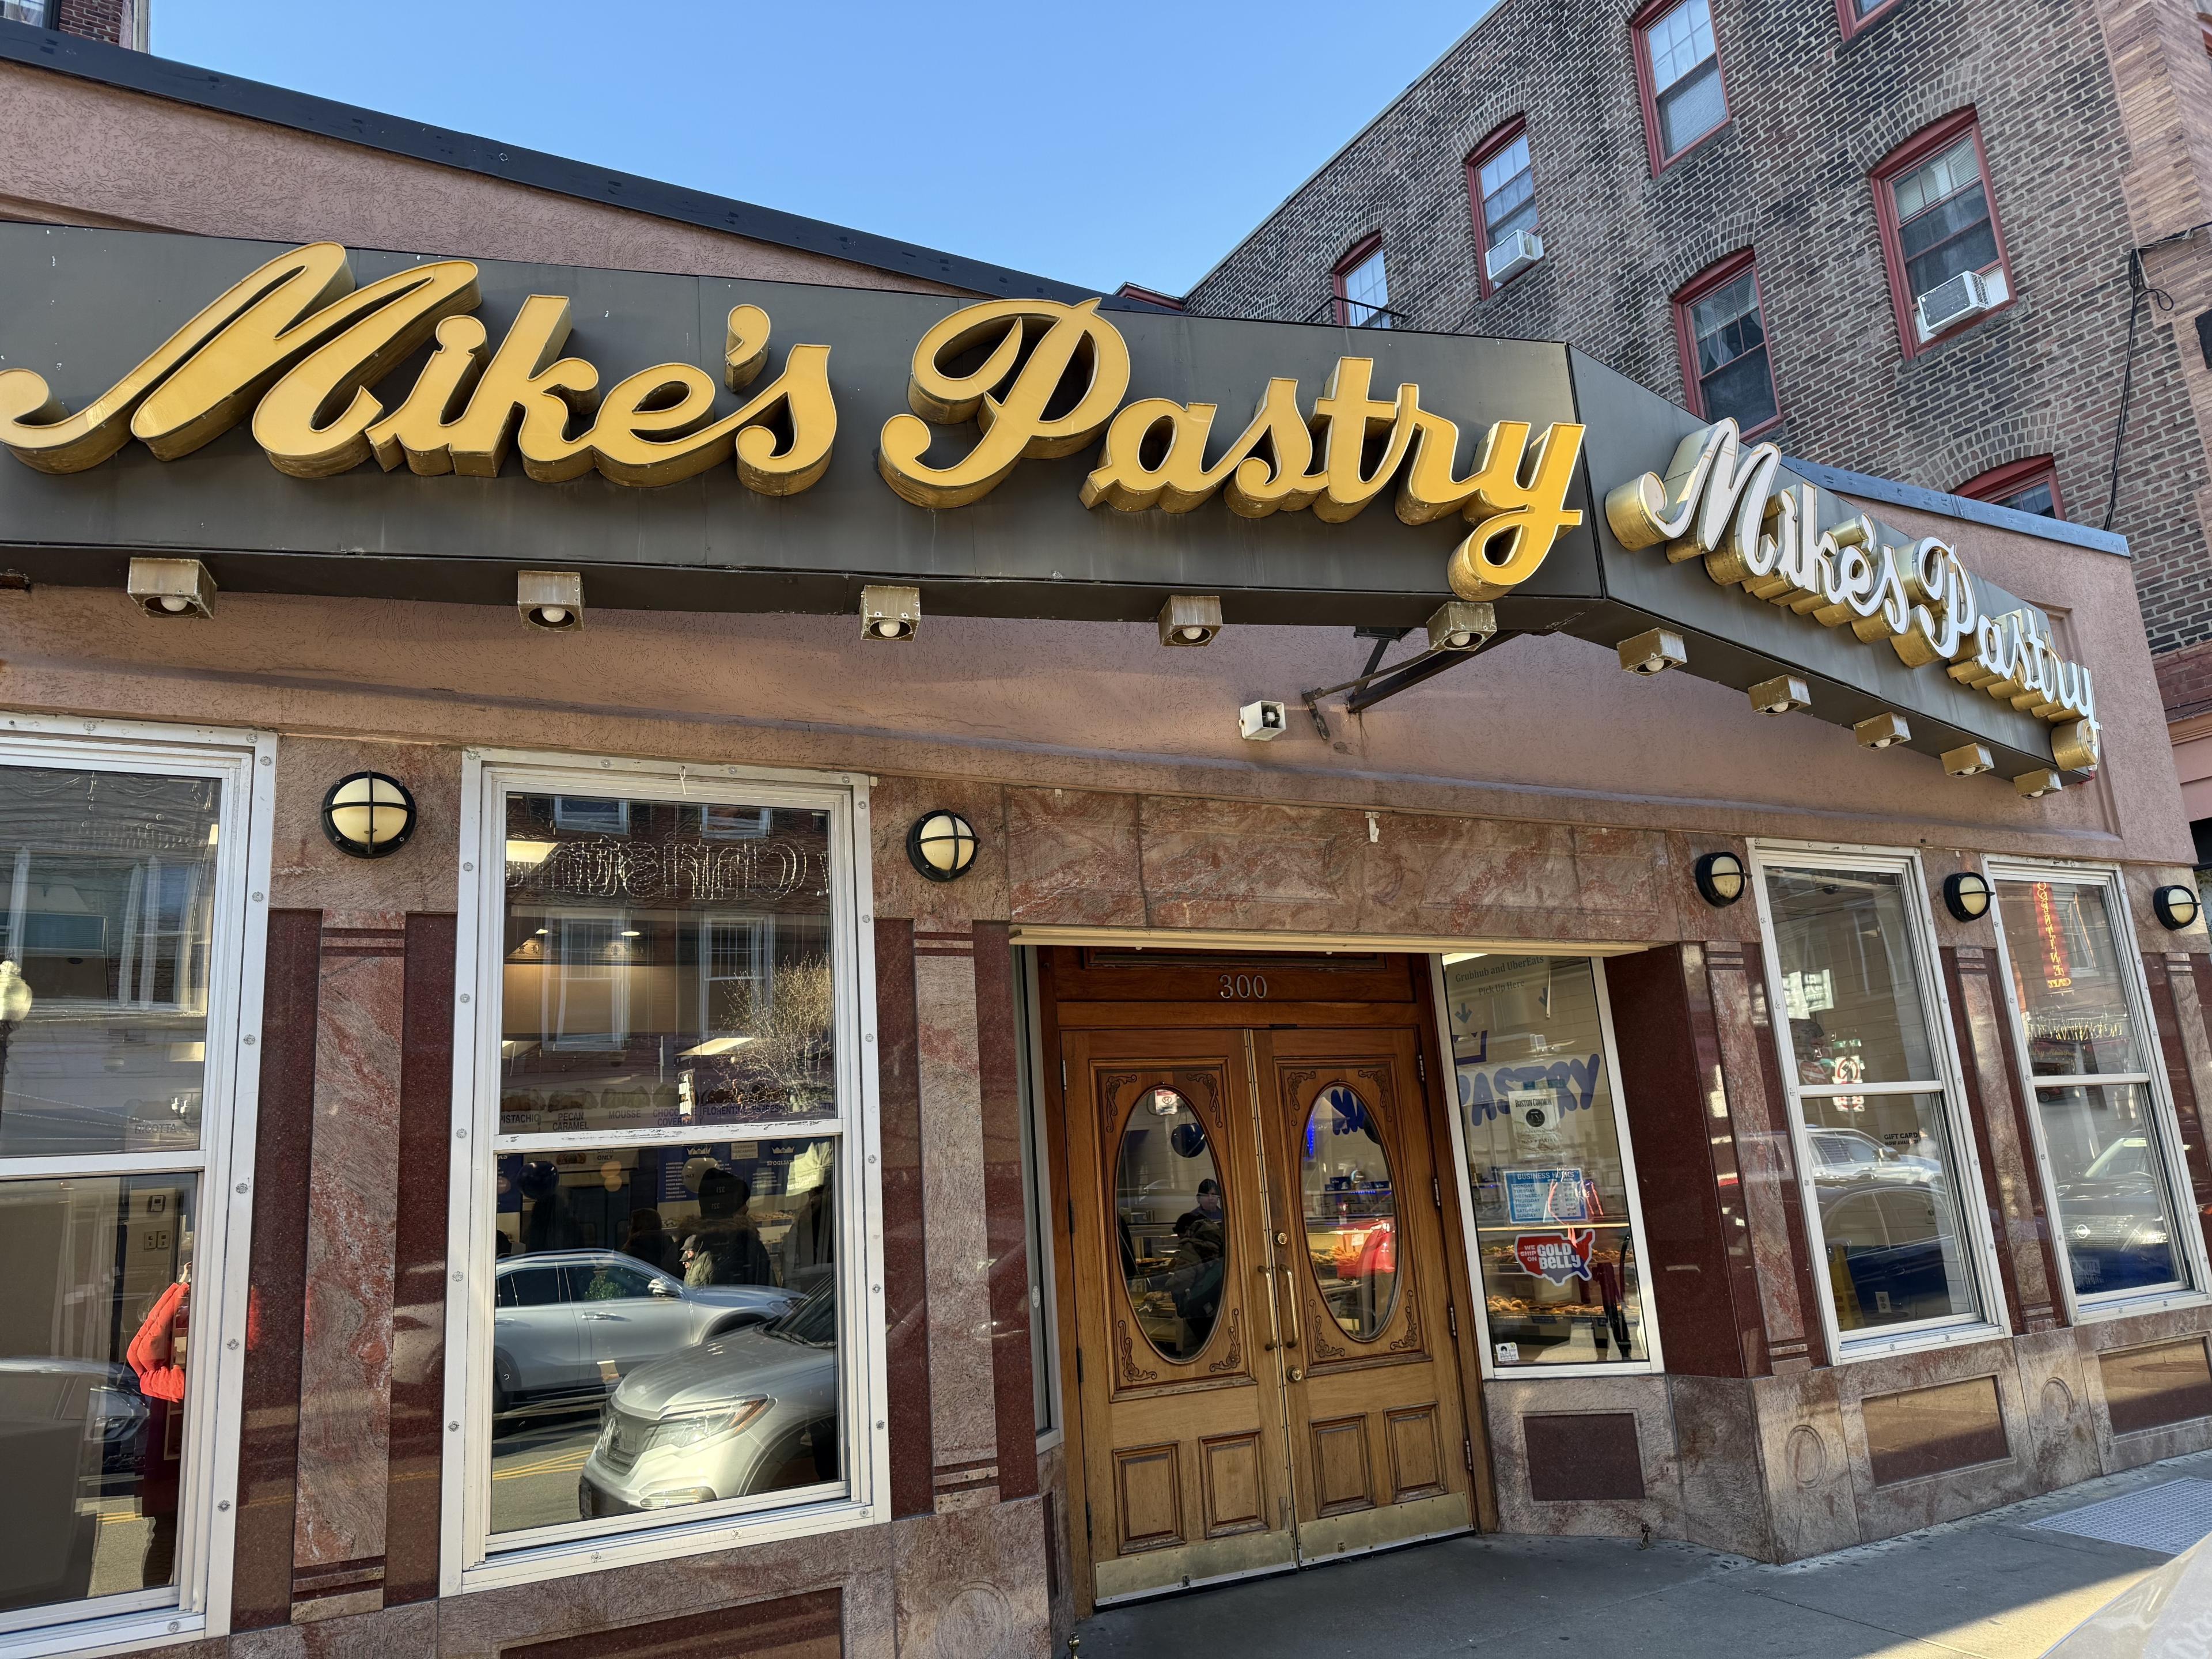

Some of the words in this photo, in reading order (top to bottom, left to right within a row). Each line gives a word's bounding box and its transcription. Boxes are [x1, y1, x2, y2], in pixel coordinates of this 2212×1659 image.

[0, 242, 839, 490] Mike's
[880, 297, 1586, 598] Pastry
[1606, 417, 1910, 641] Mike's
[1892, 536, 2103, 770] Pastry
[1456, 967, 1489, 982] Grubhub
[1491, 965, 1505, 975] and
[1507, 956, 1544, 970] UberEats
[1219, 974, 1267, 999] 300
[1479, 985, 1494, 995] Pick
[1495, 984, 1505, 994] Up
[1506, 980, 1525, 990] Here
[1515, 1099, 1532, 1108] BOSTON
[1532, 1098, 1552, 1107] COMMON
[558, 1112, 584, 1121] PECAN
[608, 1109, 641, 1119] MOUSSE
[653, 1108, 696, 1118] CHOCOE
[552, 1121, 589, 1131] CARAMEL
[1517, 1172, 1551, 1180] BUSINESS
[1536, 1243, 1572, 1257] GOLD
